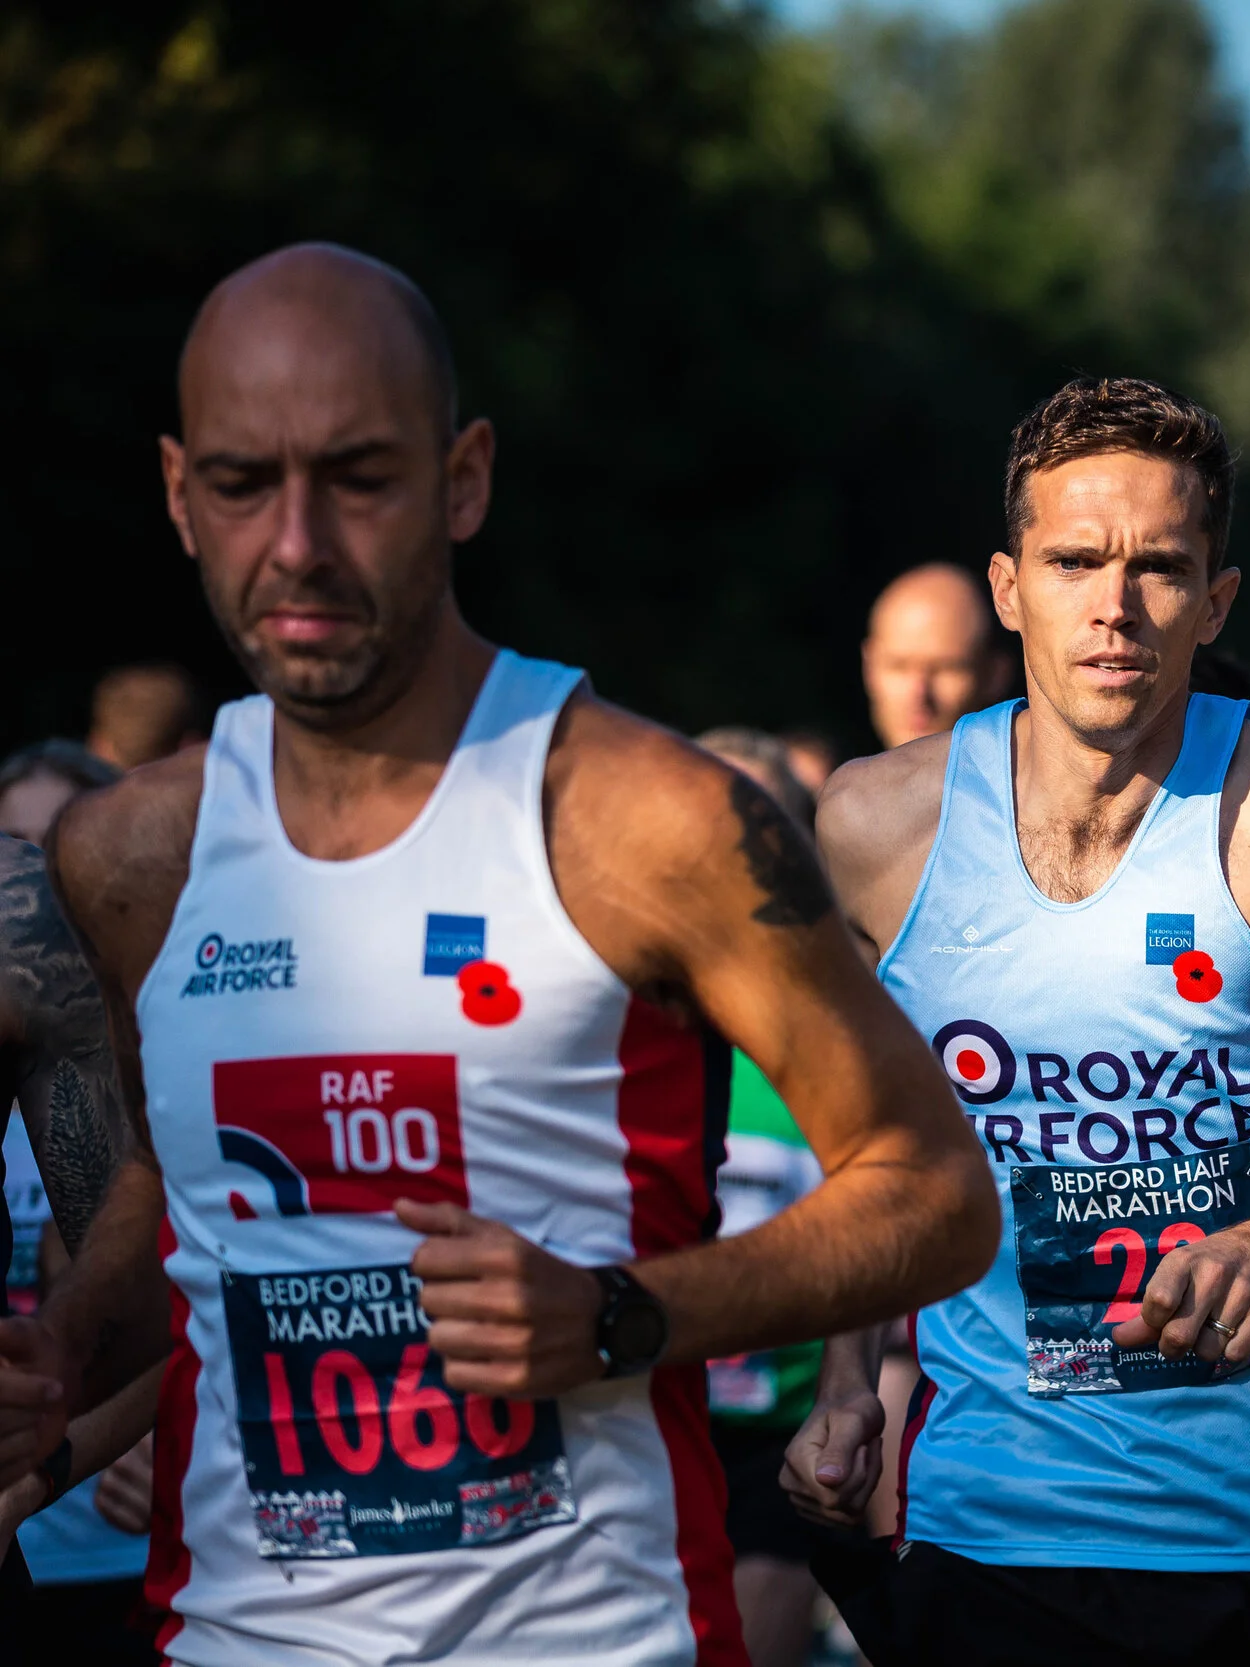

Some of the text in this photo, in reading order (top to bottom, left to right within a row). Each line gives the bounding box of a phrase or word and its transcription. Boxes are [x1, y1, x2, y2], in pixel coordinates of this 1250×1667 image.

[223, 939, 299, 967] ROYAL
[930, 945, 1013, 954] RONHILL
[1149, 936, 1192, 948] LEGION
[180, 965, 298, 999] AIR FORCE
[320, 1070, 395, 1104] RAF
[323, 1107, 440, 1174] 100
[1050, 1153, 1230, 1194] BEDFORD HALF
[1056, 1178, 1236, 1223] MARATHON
[258, 1271, 393, 1306] BEDFORD
[266, 1300, 431, 1343] MARATH
[1117, 1350, 1157, 1367] james
[1131, 1361, 1198, 1373] FINANCIAL
